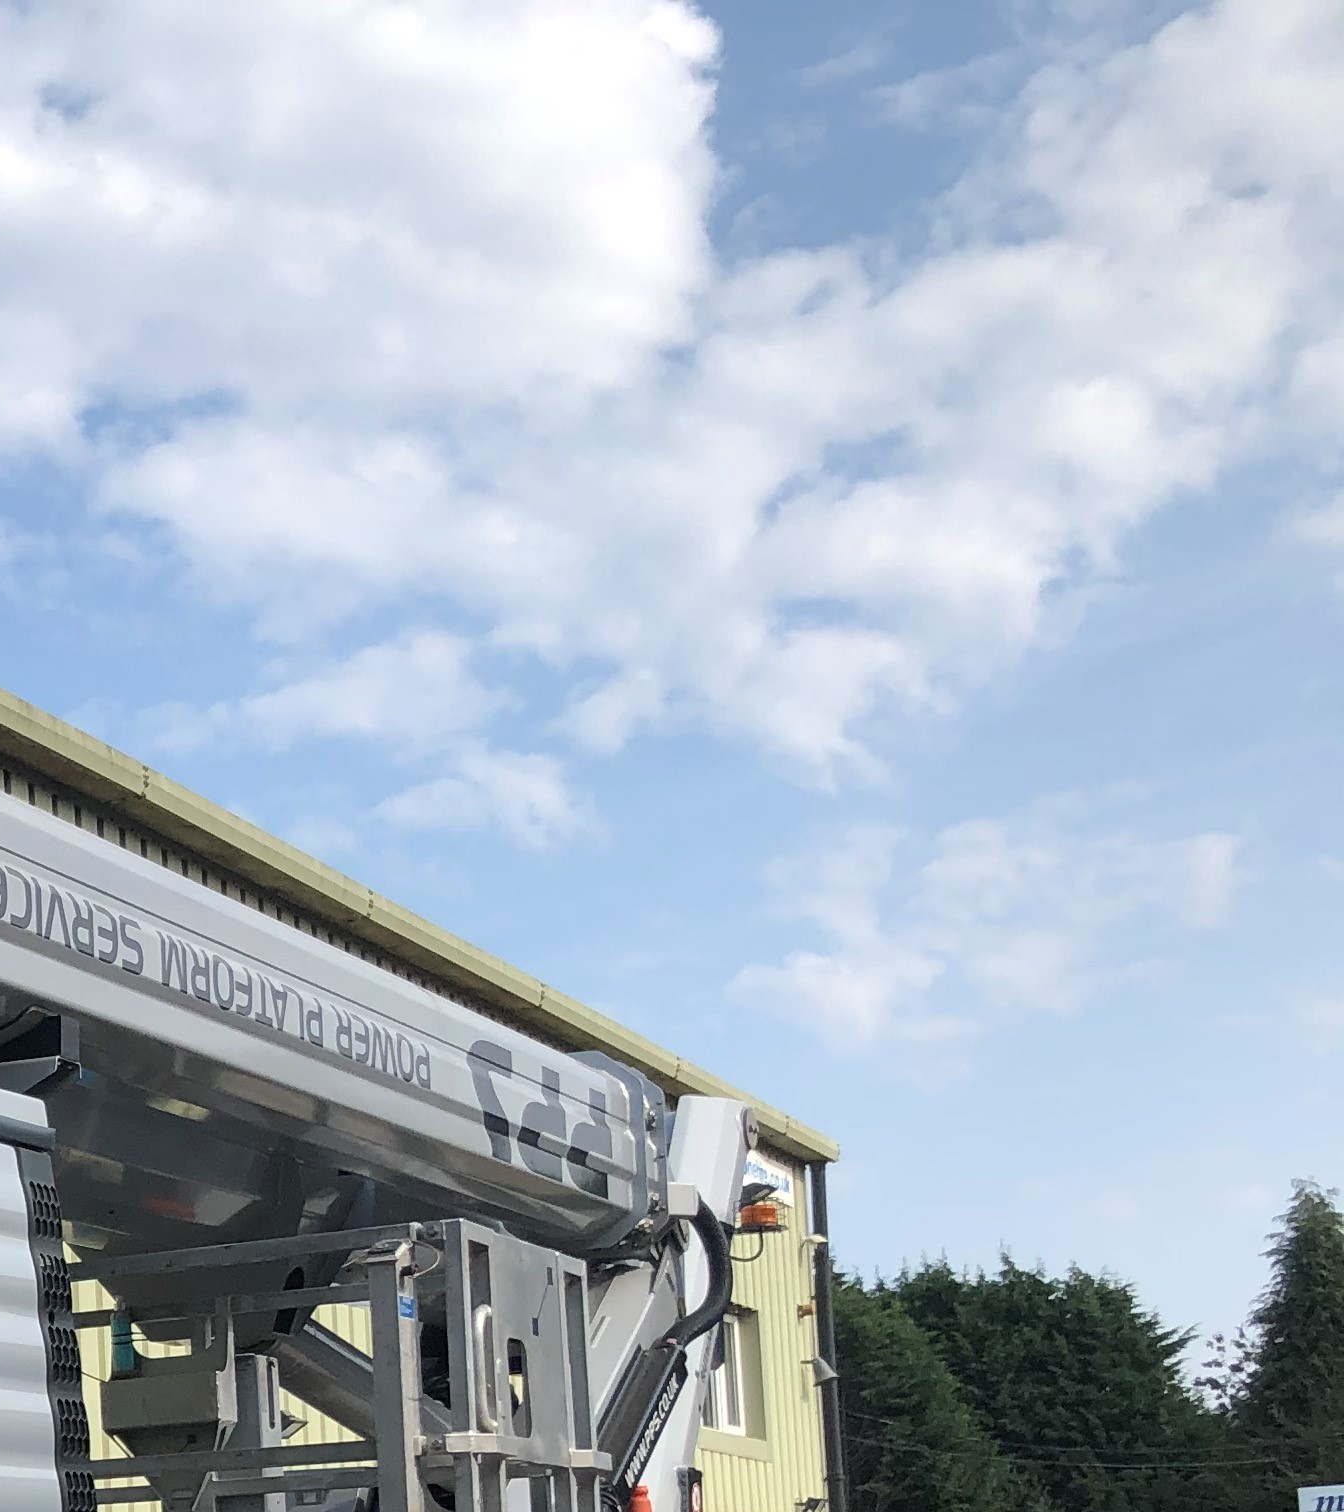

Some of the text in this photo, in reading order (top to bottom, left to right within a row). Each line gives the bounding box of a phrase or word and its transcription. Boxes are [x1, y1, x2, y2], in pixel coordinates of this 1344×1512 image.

[155, 929, 325, 1048] PLATFORM
[332, 1004, 431, 1090] POWER
[466, 1040, 612, 1200] PPS
